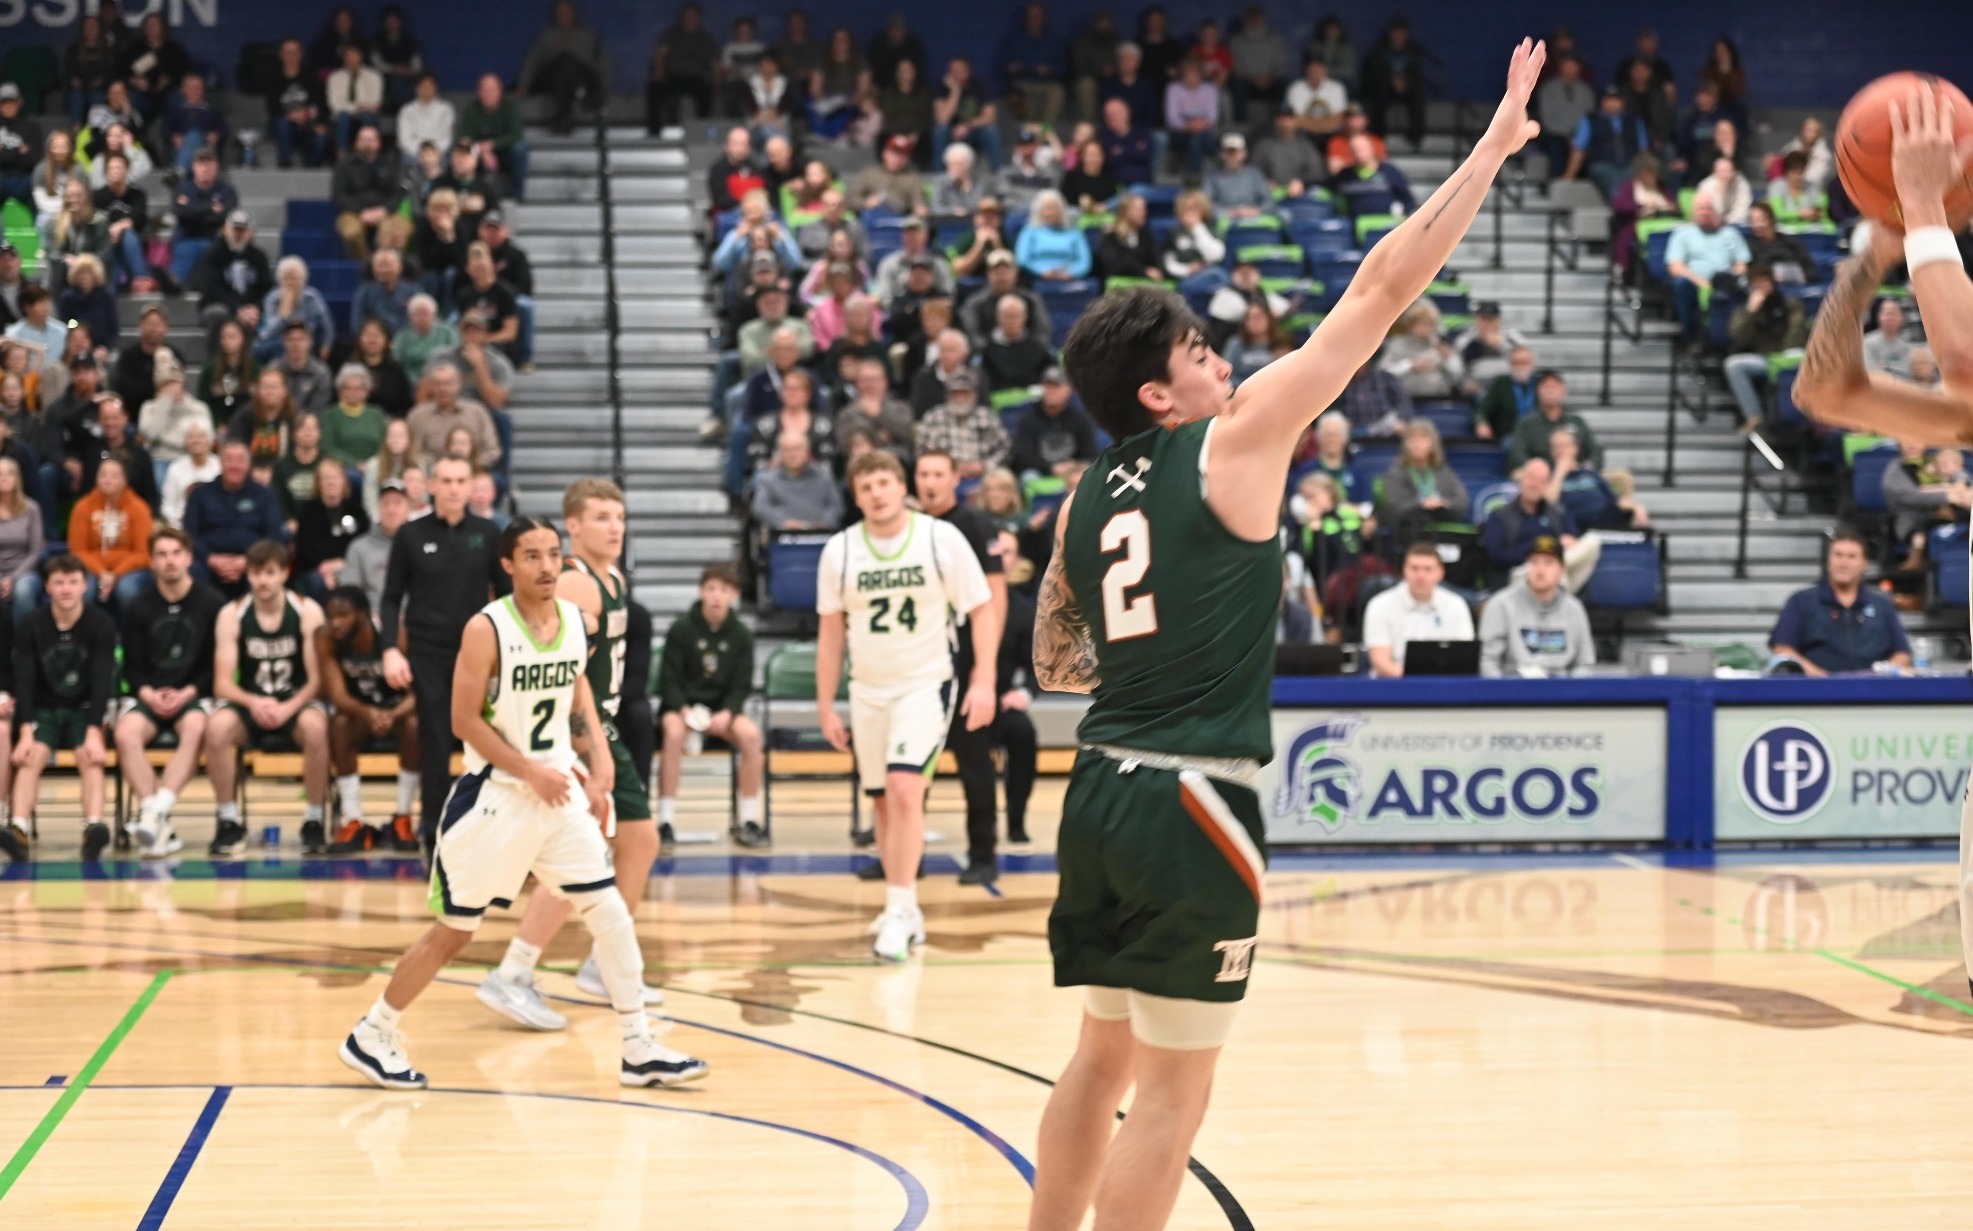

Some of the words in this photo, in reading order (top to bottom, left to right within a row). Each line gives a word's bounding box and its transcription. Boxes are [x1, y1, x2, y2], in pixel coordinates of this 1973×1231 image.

[858, 565, 925, 593] ARGOS
[1099, 508, 1159, 644] 2
[869, 596, 917, 633] 24
[255, 660, 293, 694] 42
[512, 660, 579, 692] ARGOS
[529, 698, 556, 752] 2
[1362, 733, 1455, 750] UNIVERSITY
[1458, 734, 1483, 750] OF
[1490, 733, 1603, 750] PROVIDENCE
[1851, 735, 1973, 761] UNIVE
[1367, 767, 1599, 817] ARGOS
[1852, 768, 1972, 805] PROV
